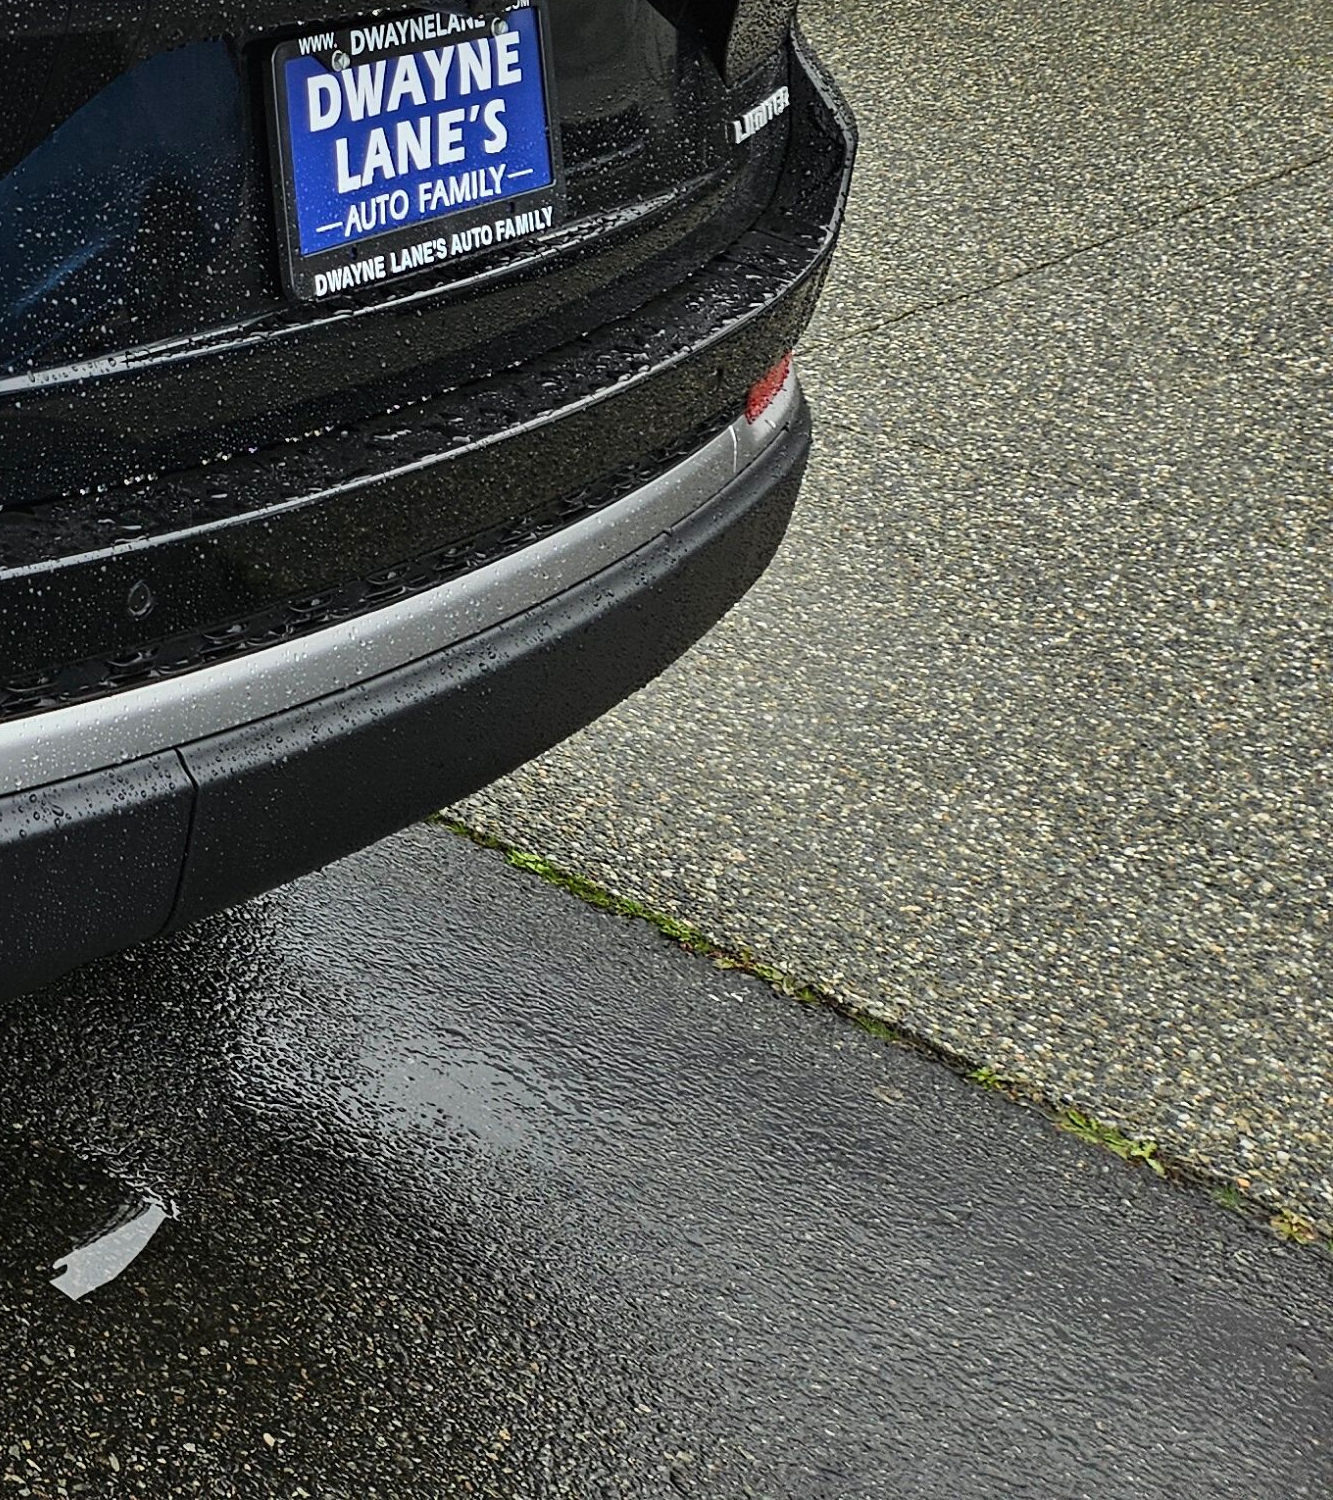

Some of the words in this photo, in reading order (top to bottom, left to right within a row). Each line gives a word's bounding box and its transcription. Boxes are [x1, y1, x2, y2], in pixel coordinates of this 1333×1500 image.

[307, 30, 522, 133] DWAYNE
[335, 98, 508, 194] LANE'S
[344, 188, 410, 237] AUTO
[418, 163, 507, 214] FAMILY
[314, 255, 387, 297] DWAYNE
[390, 238, 450, 274] LANE'S
[450, 225, 494, 256] AUTO
[495, 205, 554, 242] FAMILY
